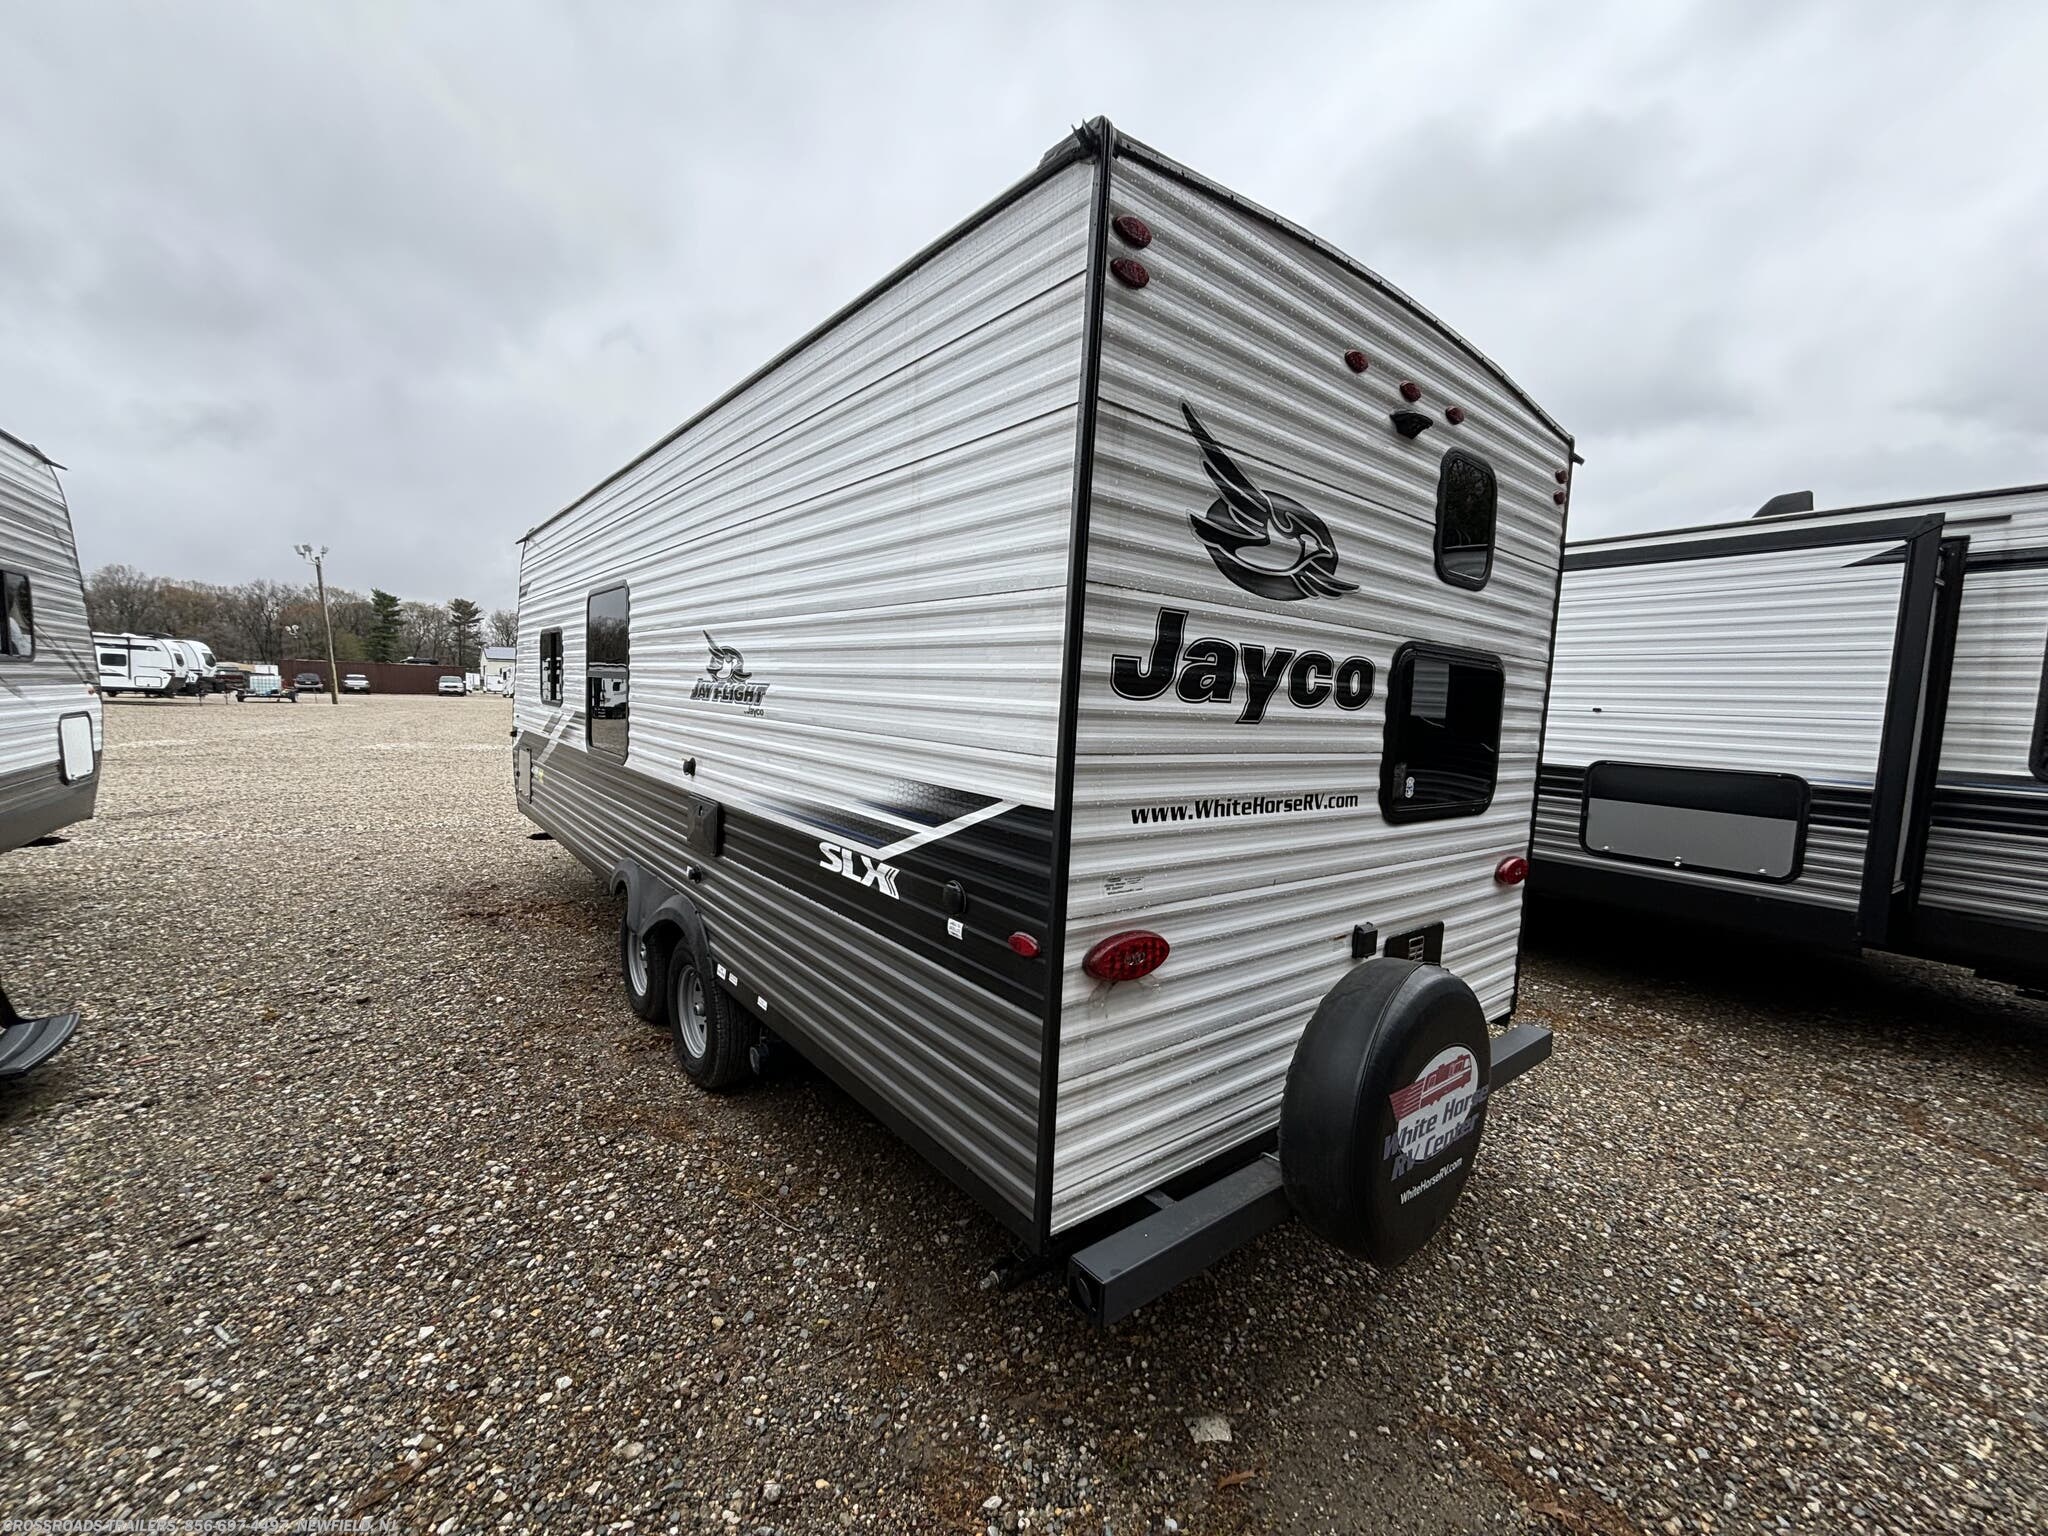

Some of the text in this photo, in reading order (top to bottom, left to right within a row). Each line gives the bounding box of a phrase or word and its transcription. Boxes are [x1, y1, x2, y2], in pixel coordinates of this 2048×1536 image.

[690, 679, 770, 706] JAY FLIGHT
[1110, 606, 1377, 725] Jayco
[1130, 793, 1359, 825] www.WhiteHorseRV.com
[818, 841, 900, 900] SLX
[1383, 1084, 1489, 1161] White Horse
[1391, 1111, 1480, 1182] RV Center
[1400, 1157, 1463, 1205] WhiteHorseRV.com
